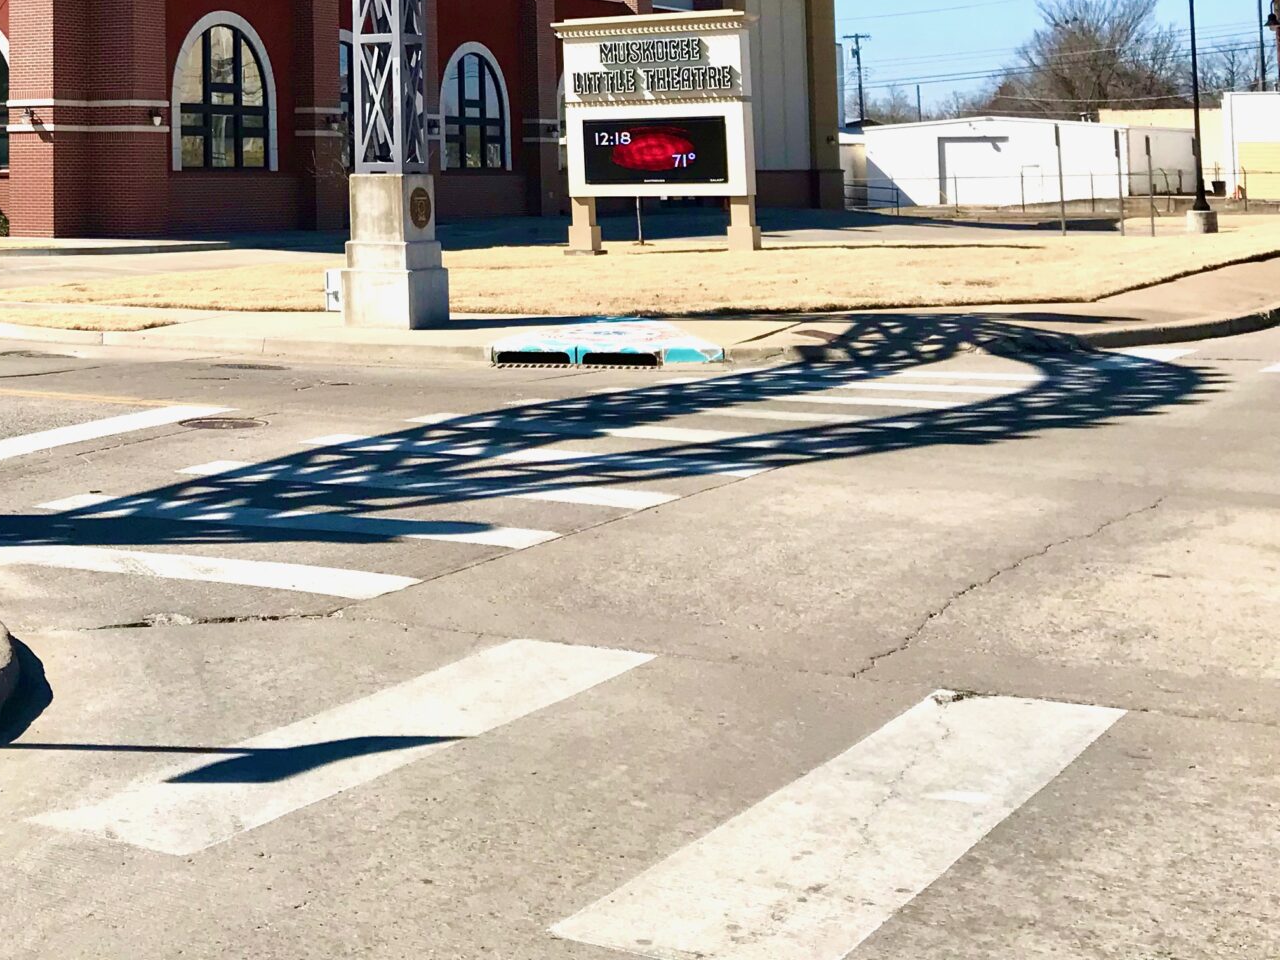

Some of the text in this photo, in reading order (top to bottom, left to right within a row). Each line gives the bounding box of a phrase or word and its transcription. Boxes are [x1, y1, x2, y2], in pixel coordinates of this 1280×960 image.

[599, 38, 701, 64] MUSKOGEE
[572, 65, 733, 95] LITTLE THEATRE
[594, 131, 632, 146] 12:18
[671, 152, 696, 168] 71°
